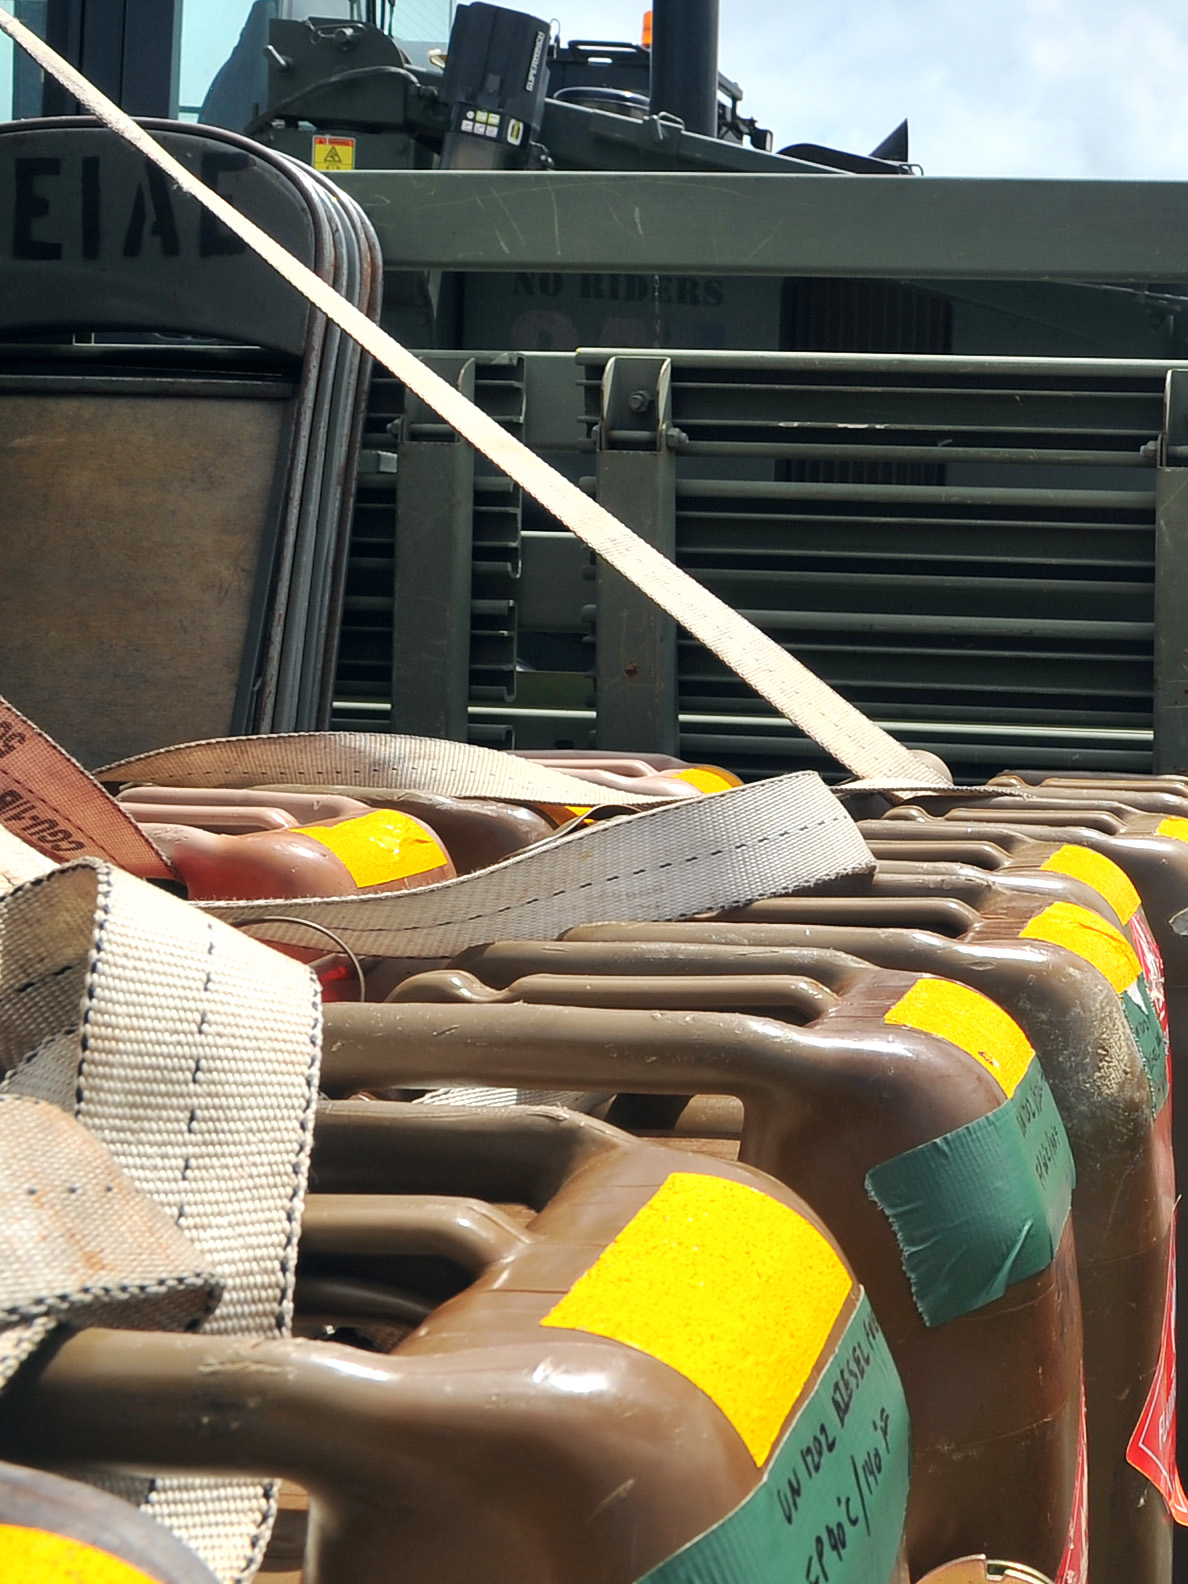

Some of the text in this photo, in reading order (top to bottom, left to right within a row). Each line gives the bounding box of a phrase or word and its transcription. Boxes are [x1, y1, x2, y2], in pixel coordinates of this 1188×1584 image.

[512, 272, 724, 306] NO RIDERS
[777, 1467, 802, 1525] UN
[800, 1422, 837, 1480] 1202
